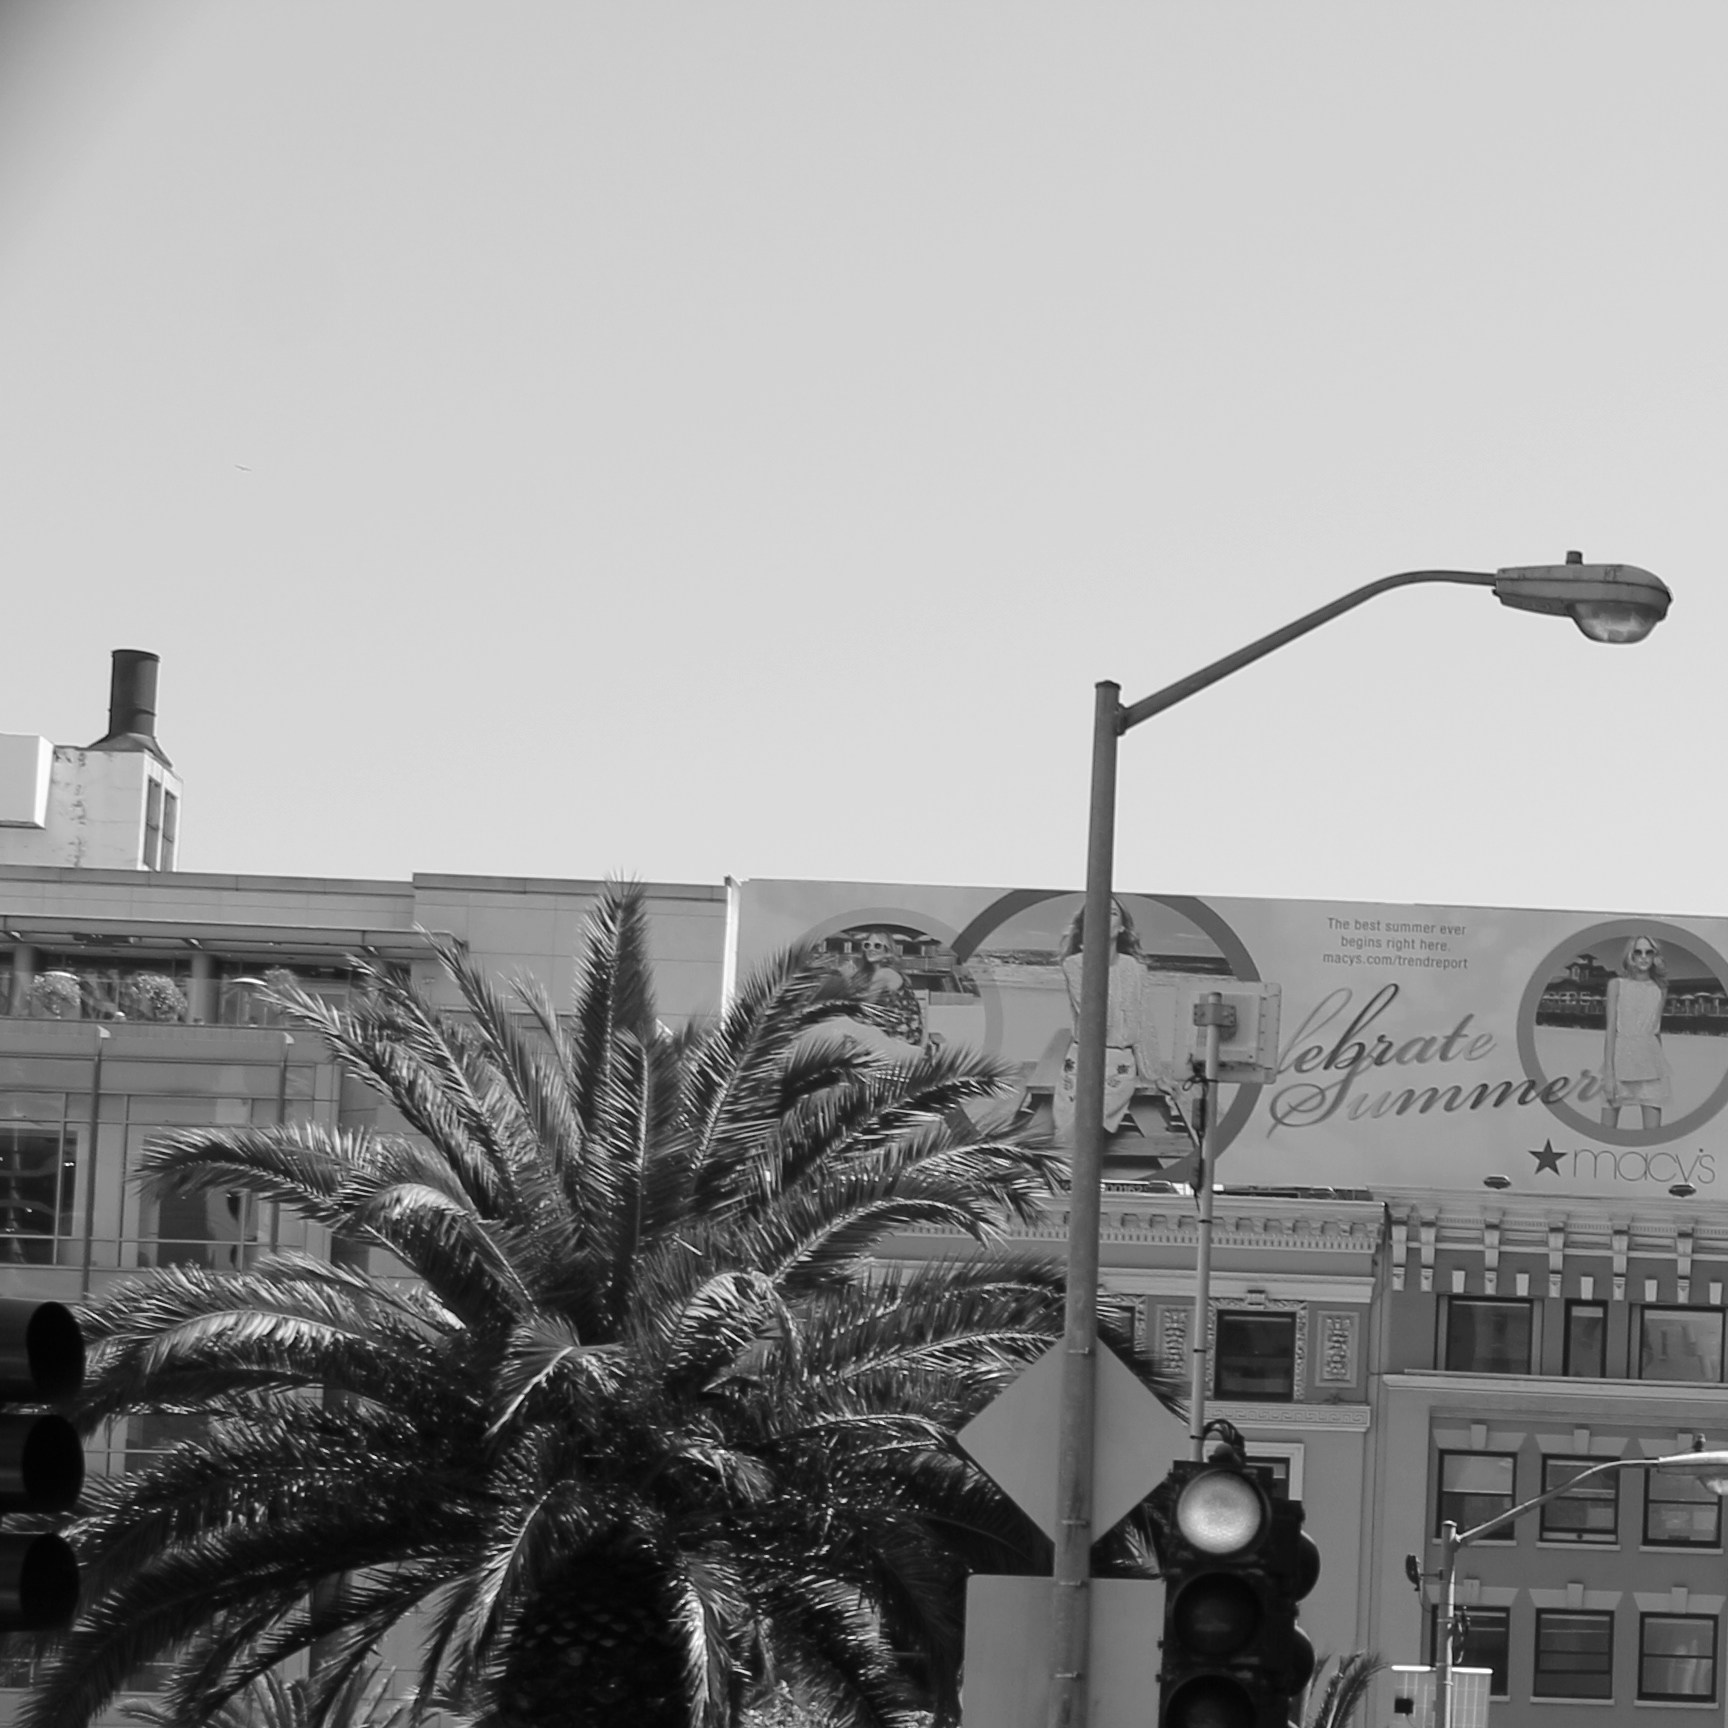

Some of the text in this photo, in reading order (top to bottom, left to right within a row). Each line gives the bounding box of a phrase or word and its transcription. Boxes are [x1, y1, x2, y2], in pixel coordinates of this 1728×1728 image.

[1328, 917, 1467, 935] The best summer ever
[1341, 936, 1382, 950] begins
[1387, 938, 1415, 952] right
[1323, 953, 1469, 970] macys.com/trendreport
[1278, 983, 1498, 1076] lebrate
[1267, 1050, 1605, 1139] Summer
